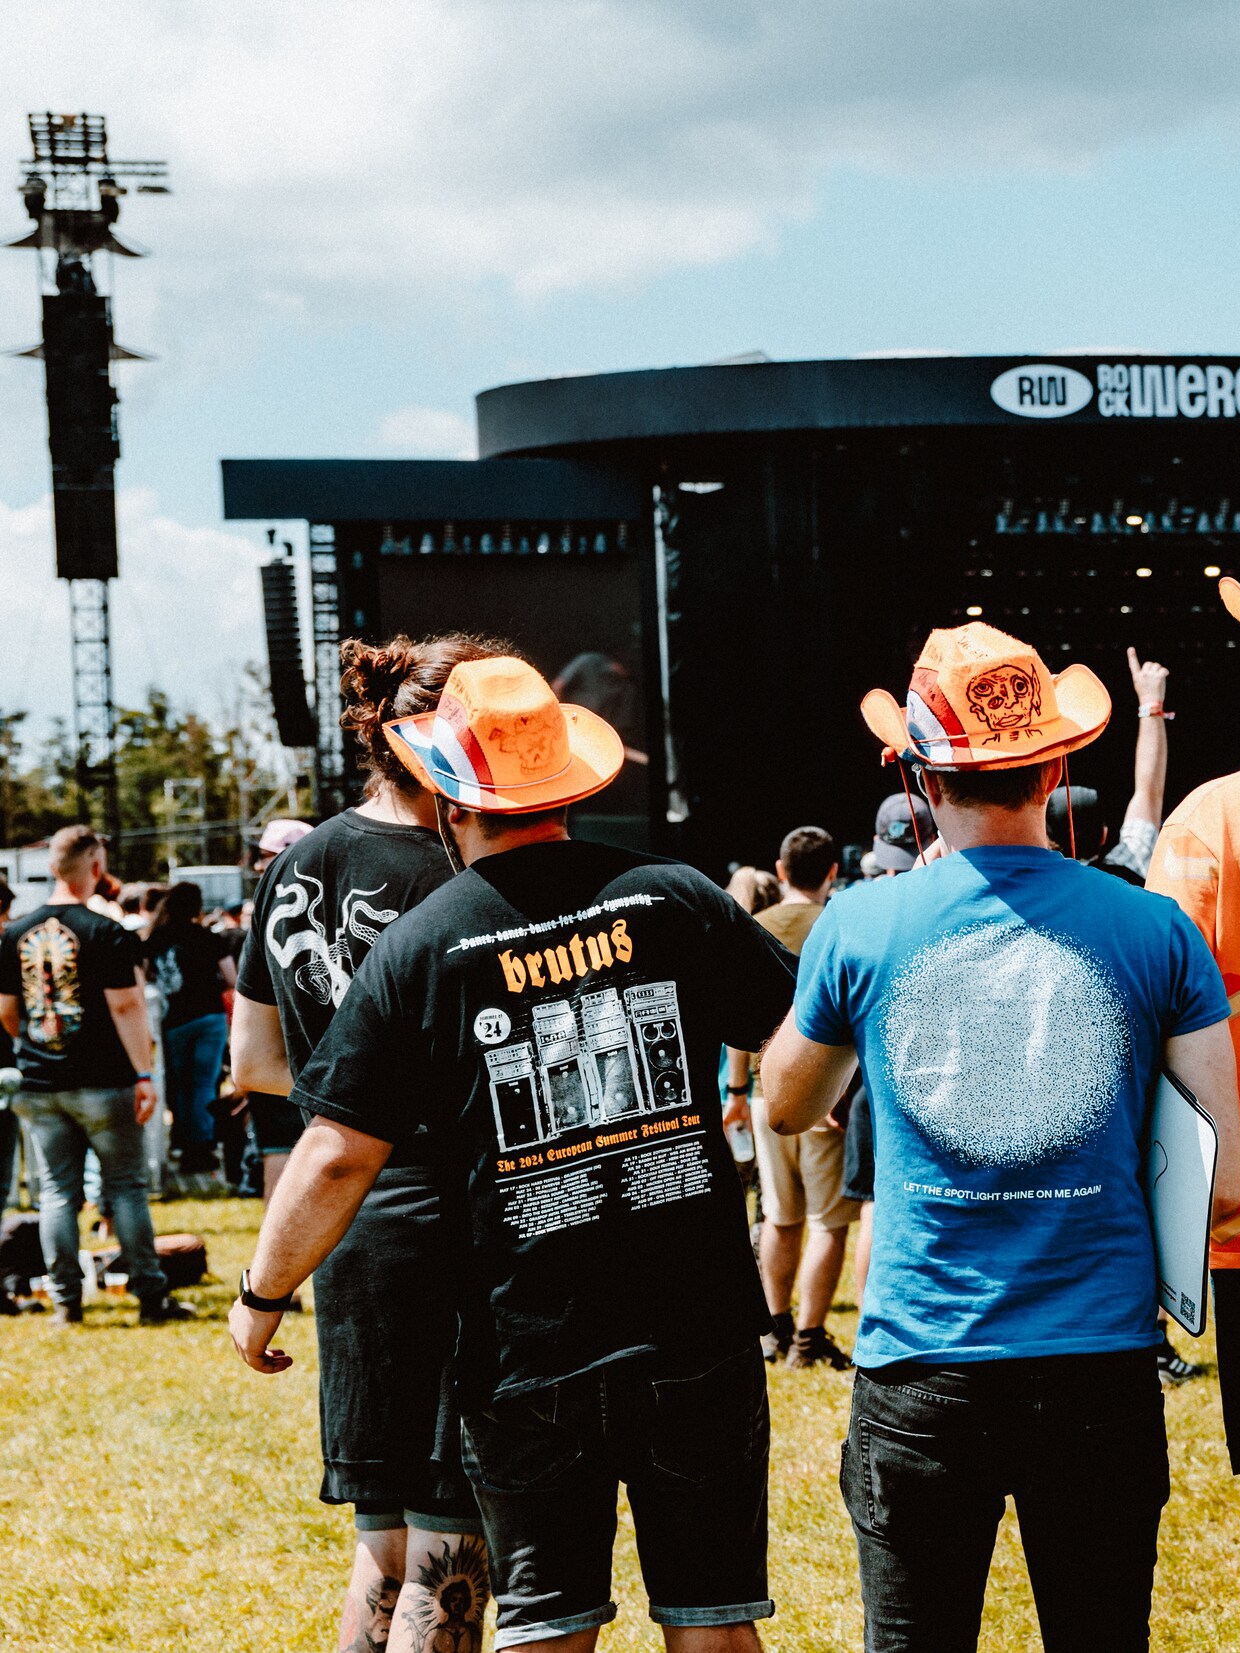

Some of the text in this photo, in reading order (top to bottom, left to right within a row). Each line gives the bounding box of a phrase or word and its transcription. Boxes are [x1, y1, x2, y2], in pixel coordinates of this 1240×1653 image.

[1019, 376, 1066, 406] RW
[498, 919, 633, 993] brutus
[497, 1159, 516, 1172] The
[519, 1153, 543, 1168] 2024
[546, 1140, 593, 1161] European
[596, 1129, 638, 1148] Summer
[641, 1117, 679, 1137] Festival
[681, 1115, 700, 1127] Tour
[903, 1181, 1102, 1200] LET THE SPOTLIGHT SHINE ON ME AGAIN
